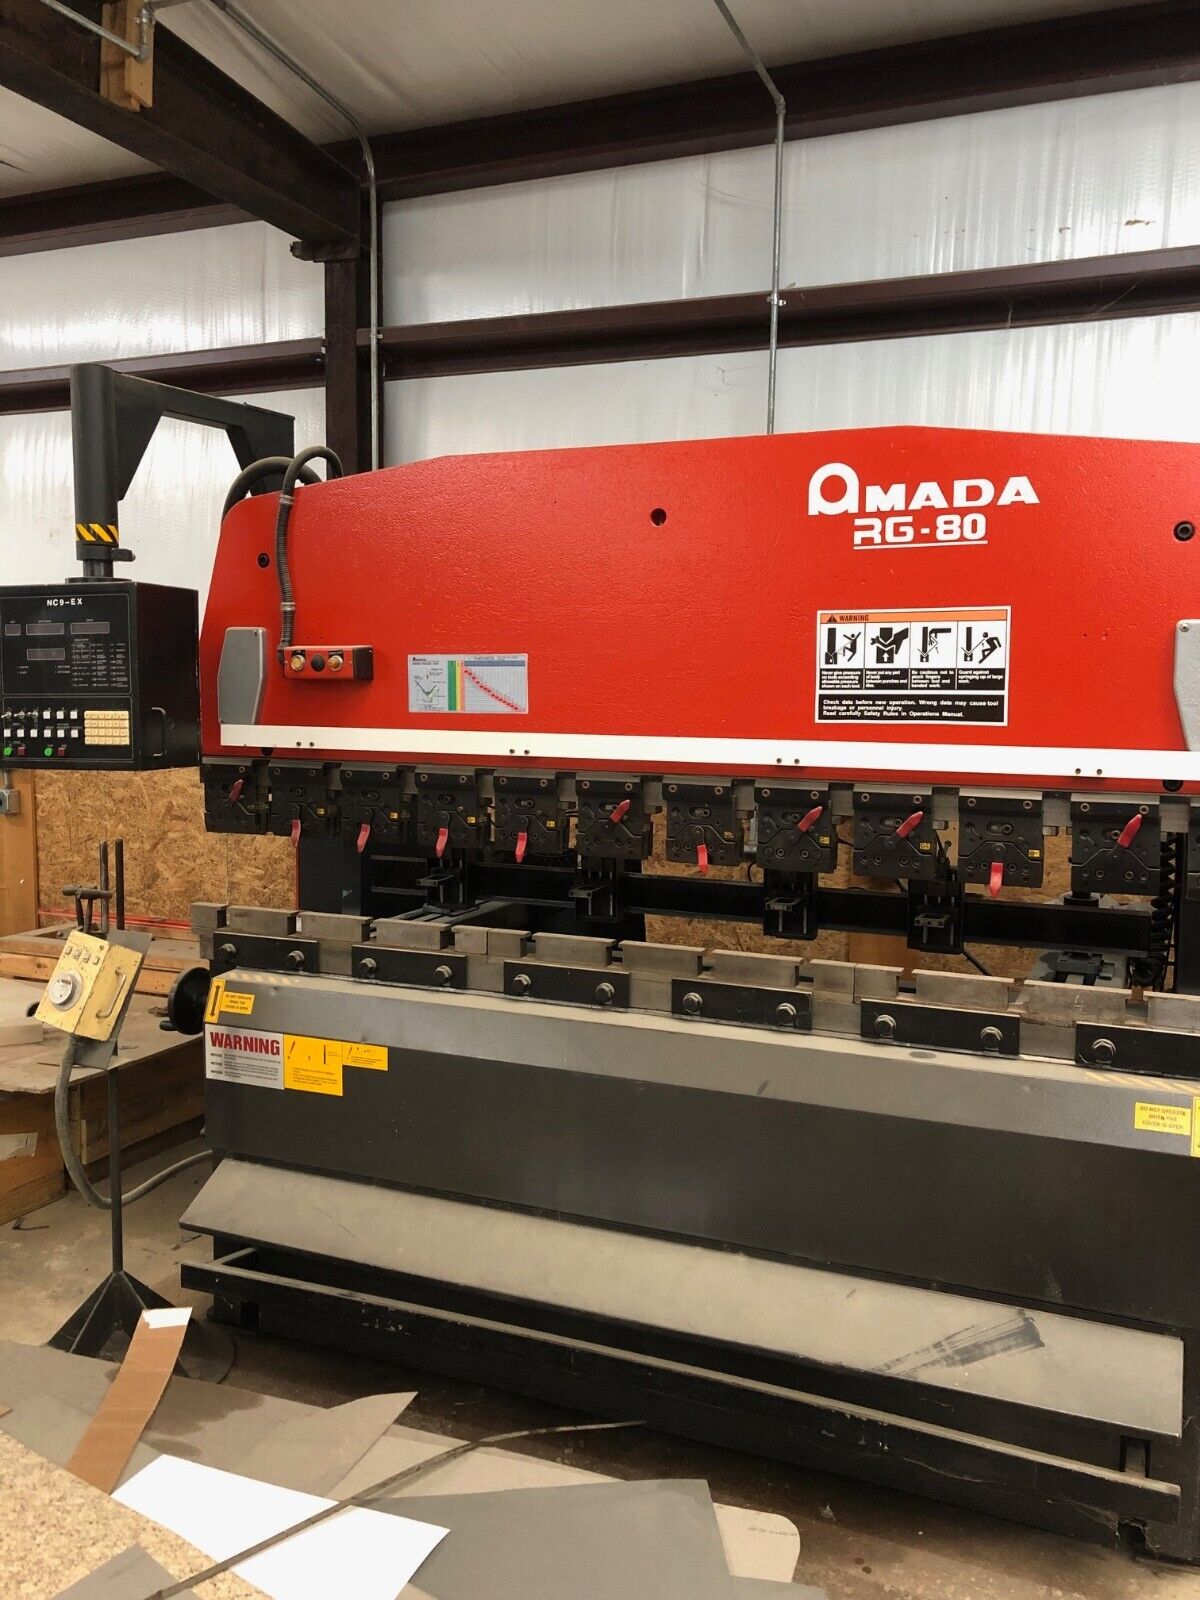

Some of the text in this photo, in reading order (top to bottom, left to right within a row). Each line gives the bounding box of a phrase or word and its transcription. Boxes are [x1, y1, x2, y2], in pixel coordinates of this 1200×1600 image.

[808, 462, 1040, 515] AMADA
[46, 598, 82, 606] NC9-EX
[839, 614, 869, 622] WARNING
[210, 1032, 280, 1056] WARNING
